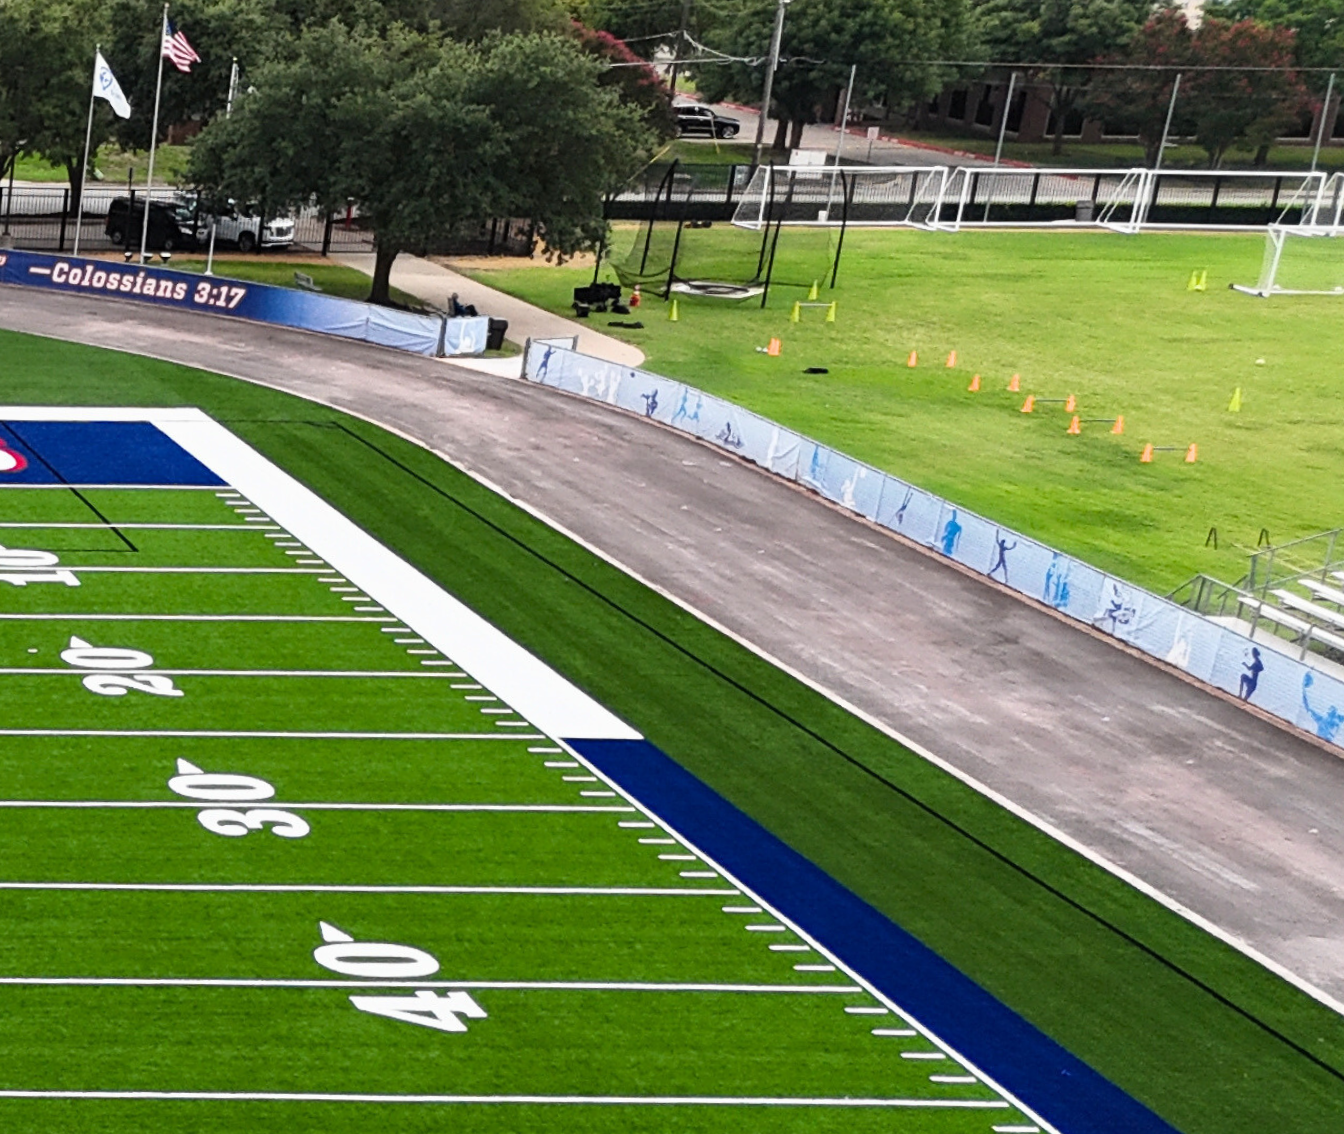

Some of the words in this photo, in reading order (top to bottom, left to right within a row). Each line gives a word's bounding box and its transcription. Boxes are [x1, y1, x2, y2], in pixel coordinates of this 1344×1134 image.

[194, 283, 246, 309] 3:17
[60, 647, 185, 697] 20
[167, 772, 311, 838] 30
[313, 942, 488, 1033] 40
